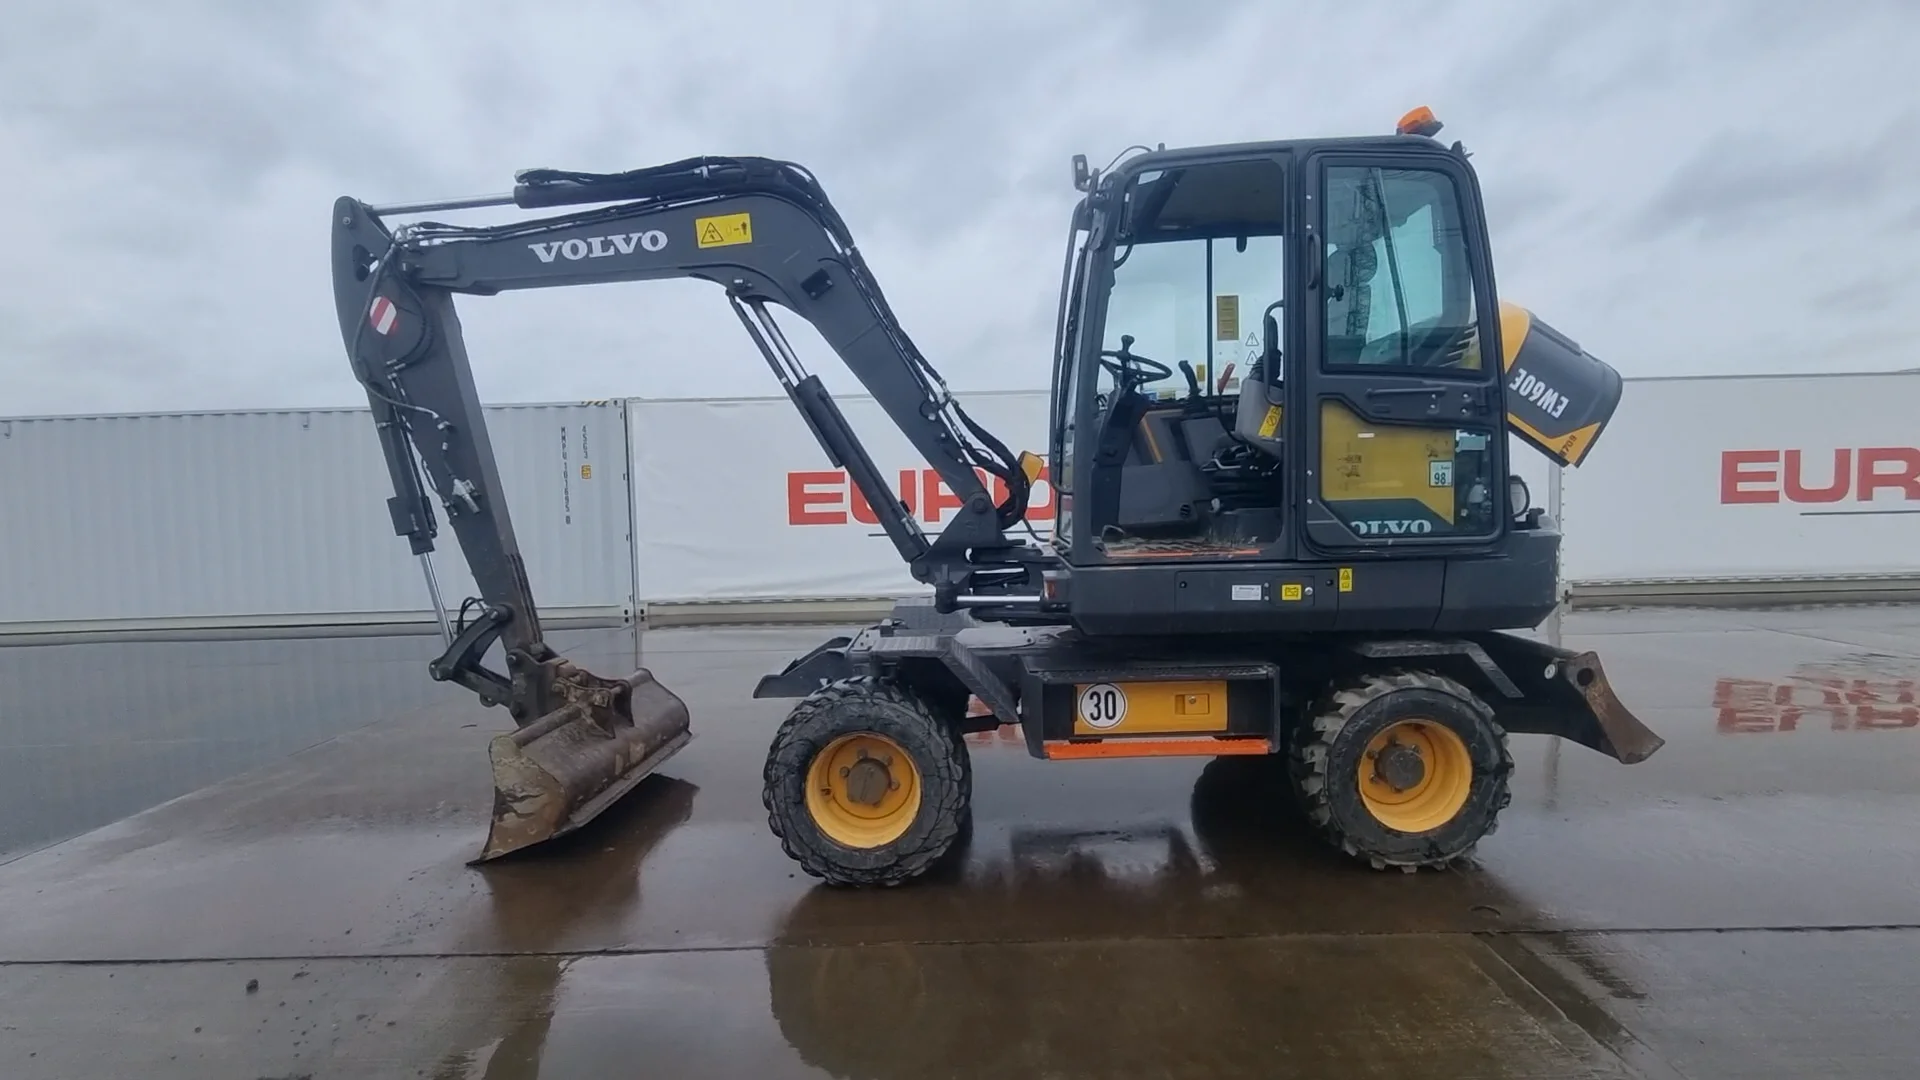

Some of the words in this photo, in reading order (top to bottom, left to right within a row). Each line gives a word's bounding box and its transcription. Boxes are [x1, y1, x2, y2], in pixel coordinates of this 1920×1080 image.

[528, 229, 668, 263] VOLVO
[1508, 367, 1570, 419] EW60E
[1434, 472, 1446, 485] 98
[1351, 519, 1432, 535] OLVO
[1089, 690, 1117, 721] 30
